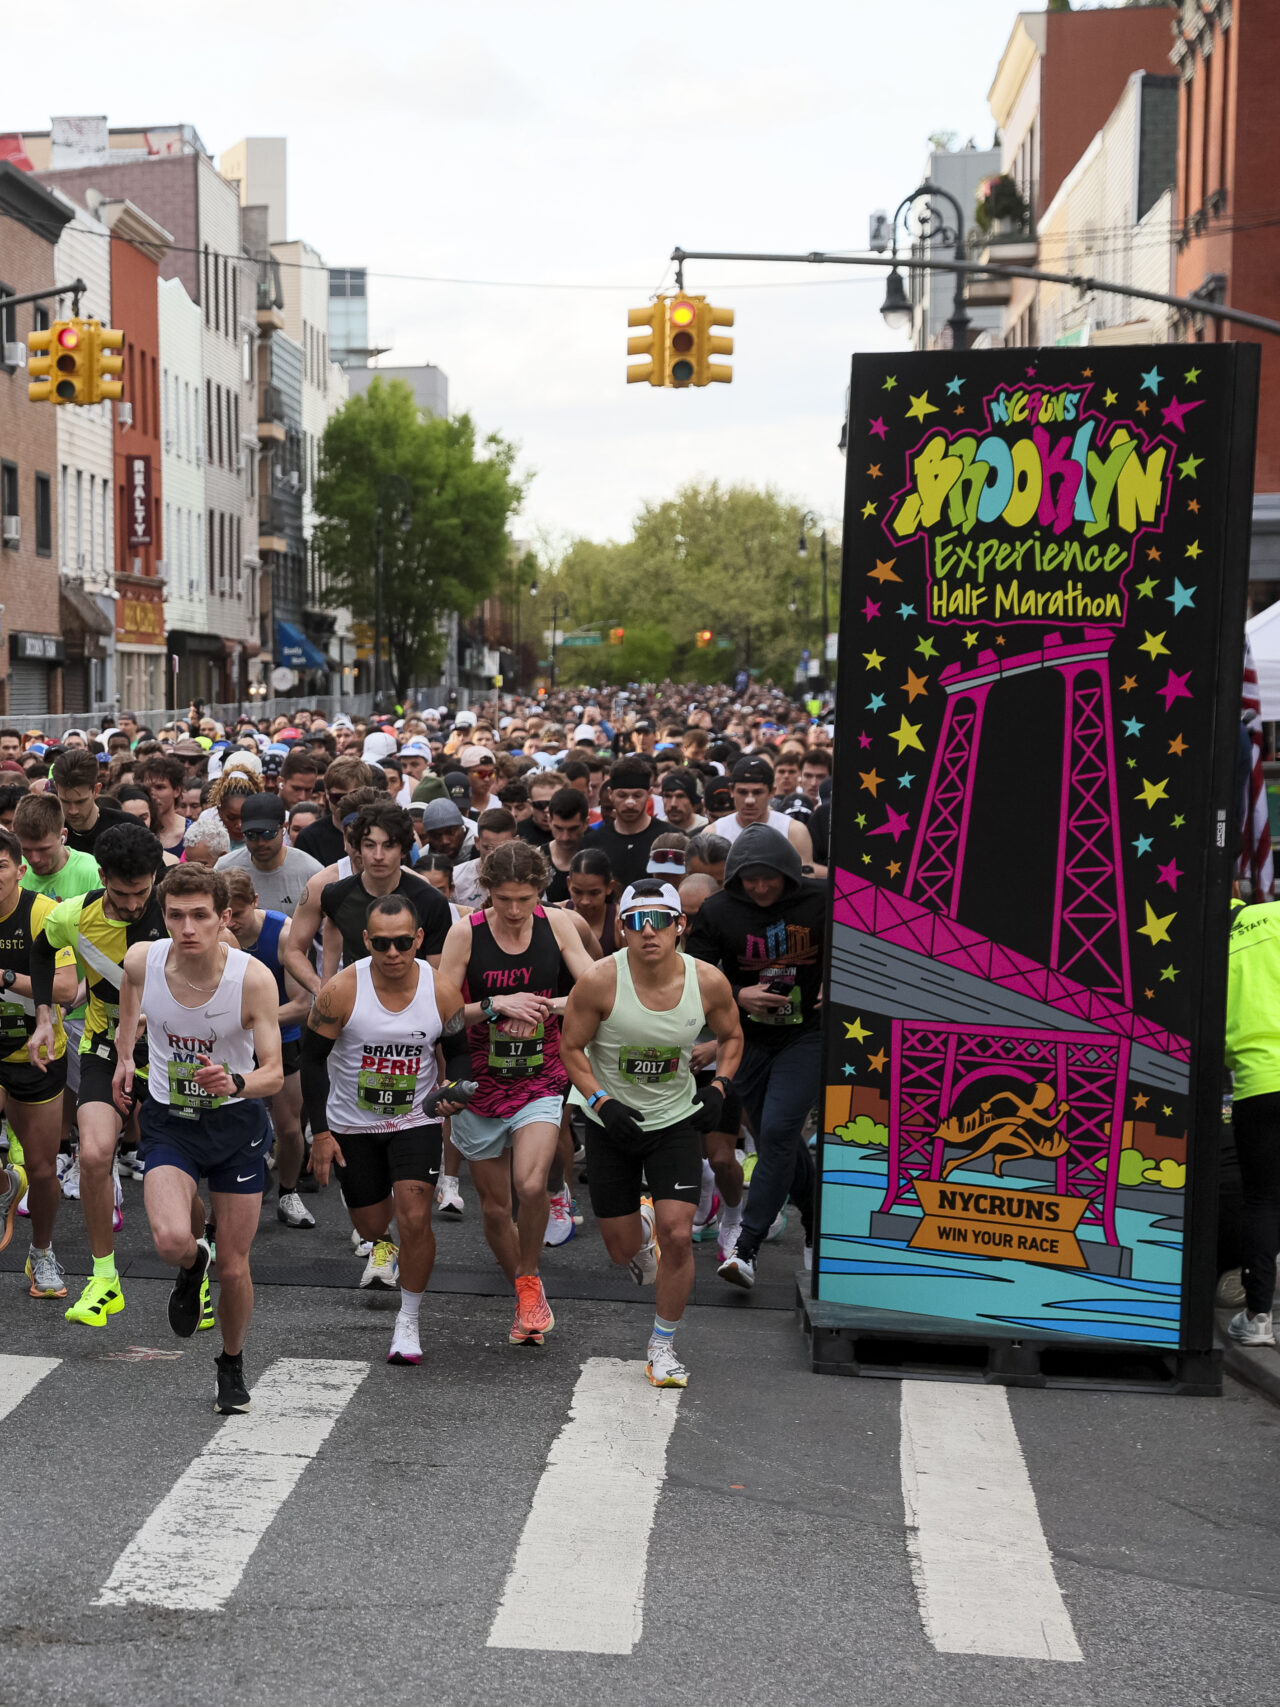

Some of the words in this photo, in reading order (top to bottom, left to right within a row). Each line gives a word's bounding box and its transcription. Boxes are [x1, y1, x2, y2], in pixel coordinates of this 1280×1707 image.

[990, 391, 1080, 426] NYCRUNS
[133, 459, 146, 536] REALTY
[934, 531, 1127, 583] Experience
[933, 580, 988, 616] Half
[995, 580, 1121, 618] Marathon
[1238, 917, 1269, 936] STAFF
[0, 939, 25, 949] GSTC
[482, 967, 532, 988] THEY
[168, 1034, 214, 1053] RUN
[363, 1045, 424, 1057] BRAVES
[509, 1043, 523, 1055] 17
[361, 1055, 420, 1075] PERU
[634, 1061, 665, 1073] 2017
[184, 1081, 216, 1096] 198
[377, 1090, 393, 1104] 16
[938, 1190, 1060, 1222] NYCRUNS
[937, 1226, 970, 1242] WIN
[972, 1229, 1013, 1249] YOUR
[1017, 1235, 1059, 1254] RACE
